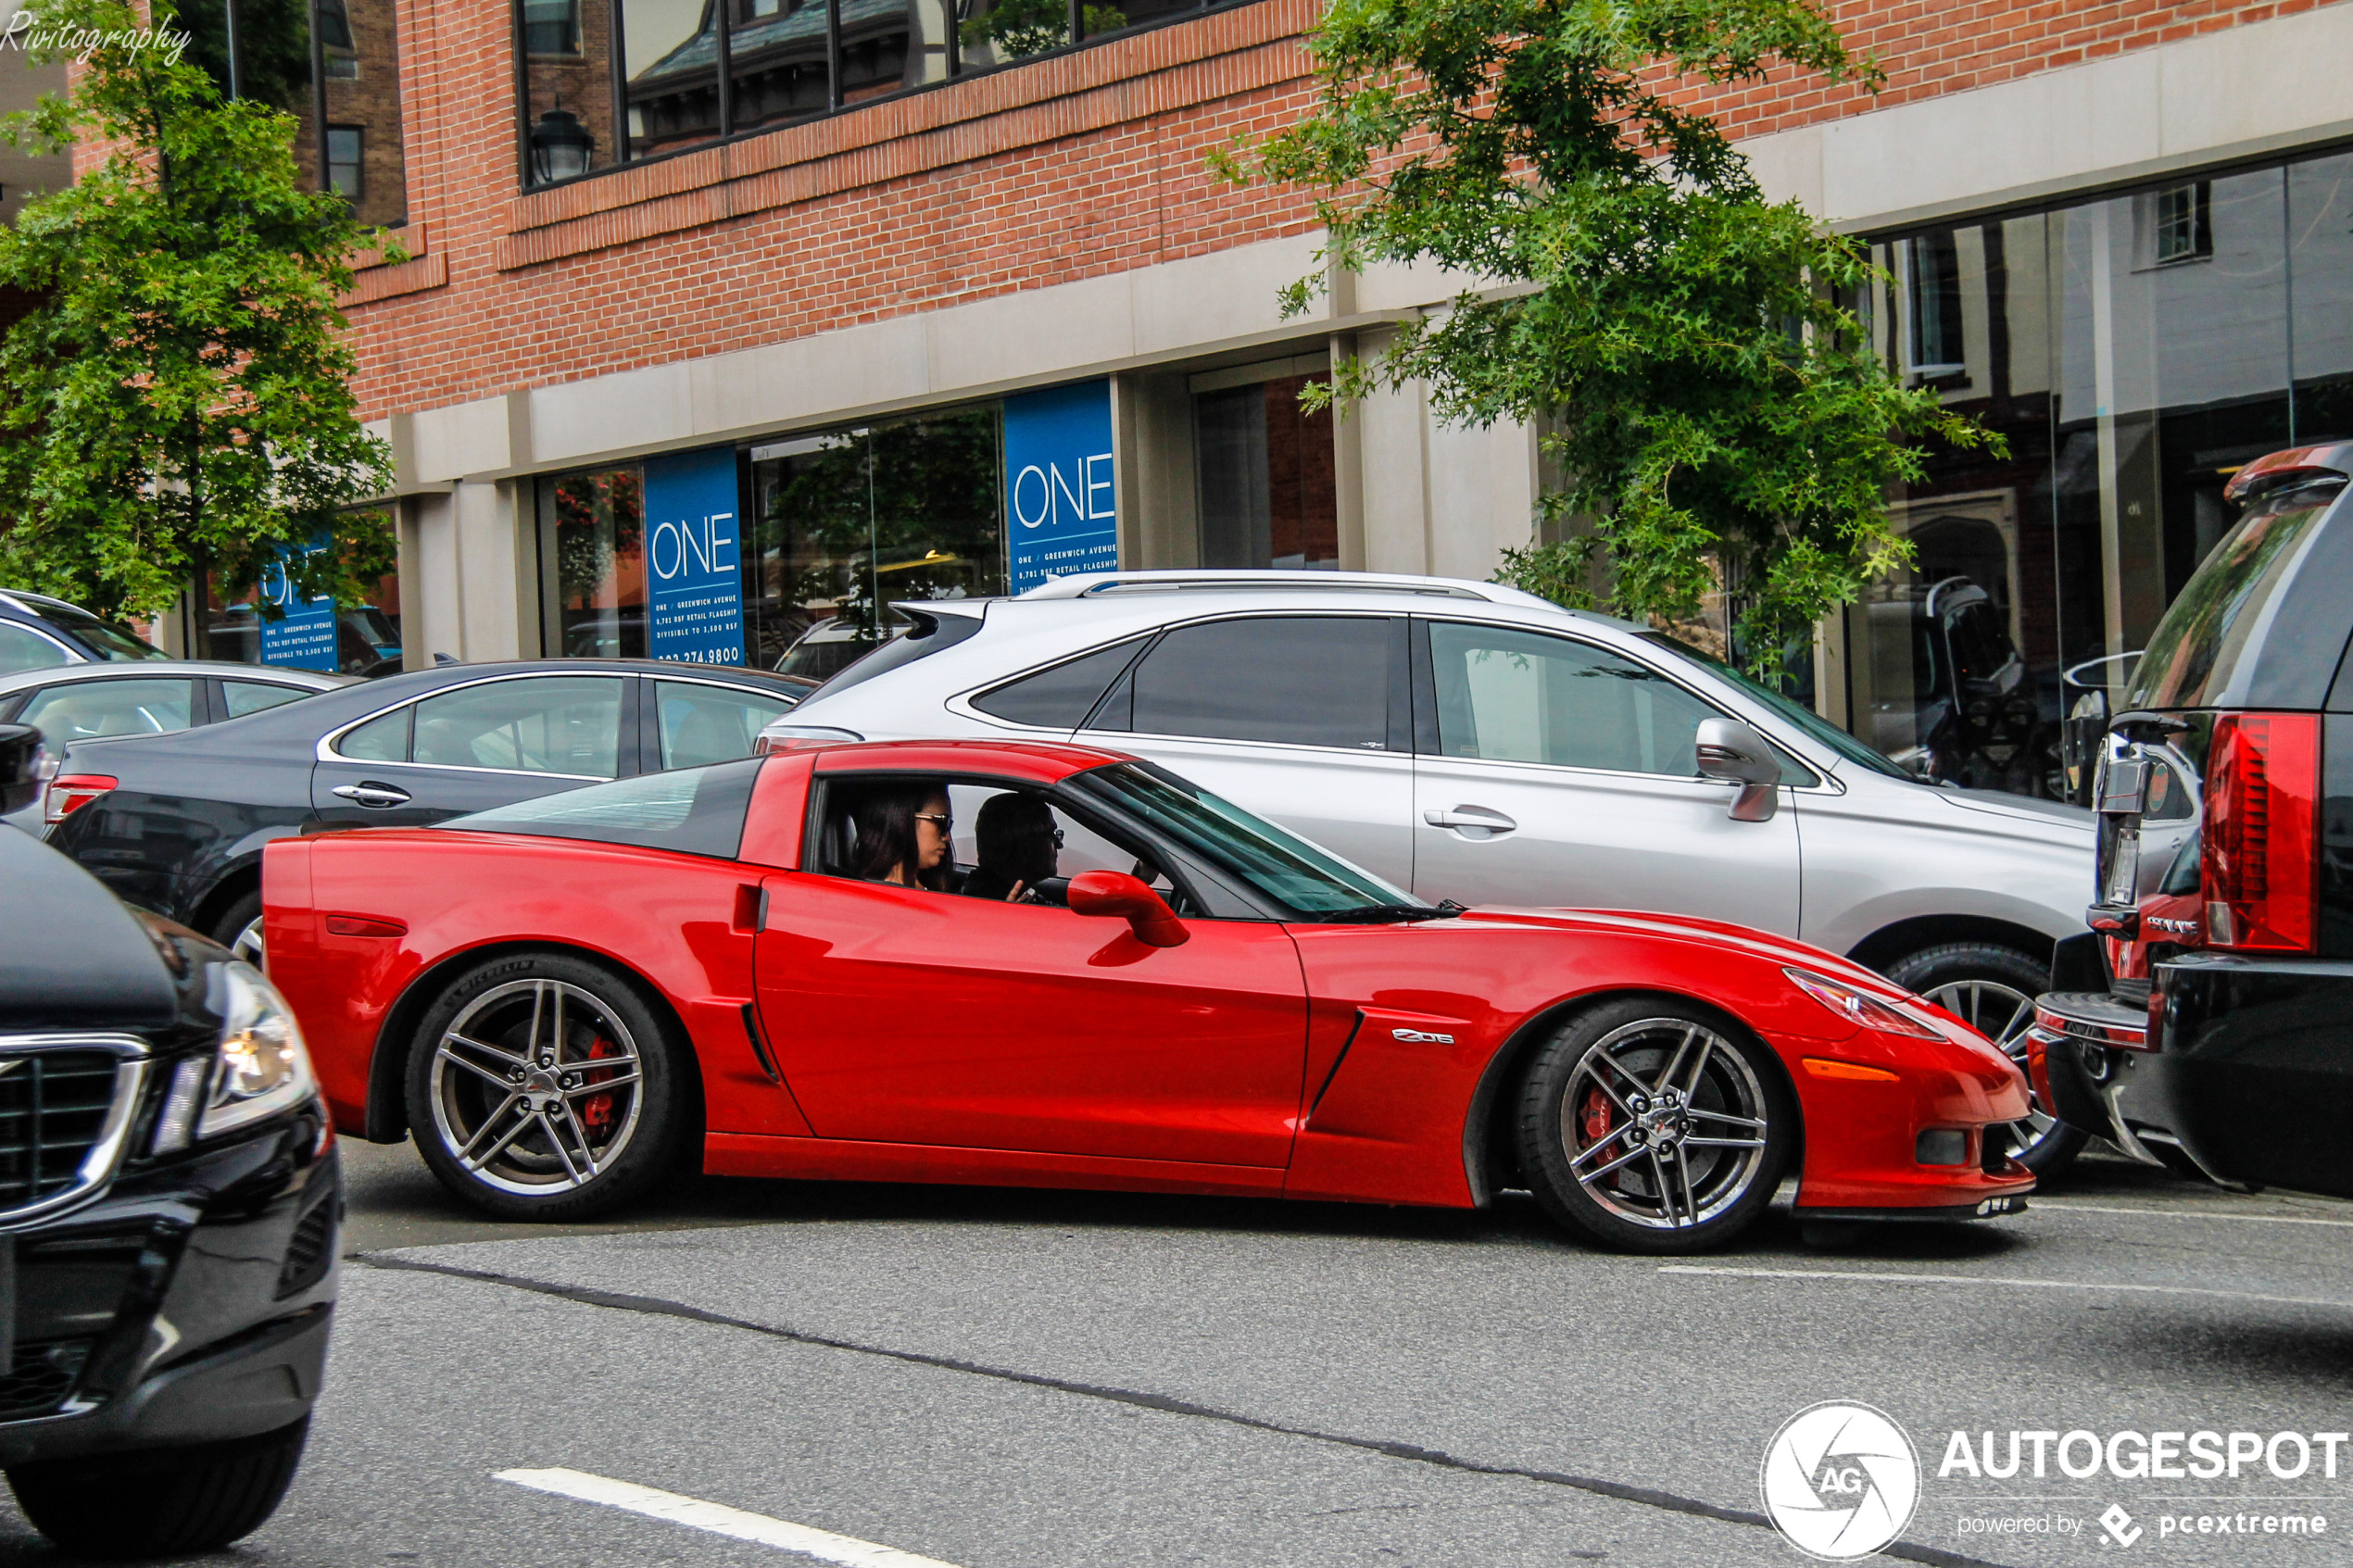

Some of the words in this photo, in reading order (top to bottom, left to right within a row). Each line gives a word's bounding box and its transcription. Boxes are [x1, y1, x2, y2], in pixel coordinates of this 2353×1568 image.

[1014, 453, 1114, 529] ONE
[652, 512, 736, 580] ONE
[1019, 556, 1032, 564] ONE
[1044, 548, 1085, 560] GREENWICH
[1089, 544, 1116, 554] AVENUE
[1040, 568, 1052, 576] RSF
[1056, 565, 1080, 574] RETAIL
[1083, 559, 1117, 571] FLAGSHIP
[677, 598, 711, 608] GREENWICH
[713, 595, 736, 604] AVENUE
[709, 608, 737, 618] FLAGSHIP
[284, 624, 311, 633] GREENWICH
[657, 629, 688, 639] DIVISIBLE
[704, 624, 722, 633] 3,500
[309, 633, 333, 642] FLAGSHIP
[268, 651, 294, 660] DIVISIBLE
[1391, 1028, 1455, 1044] Z06
